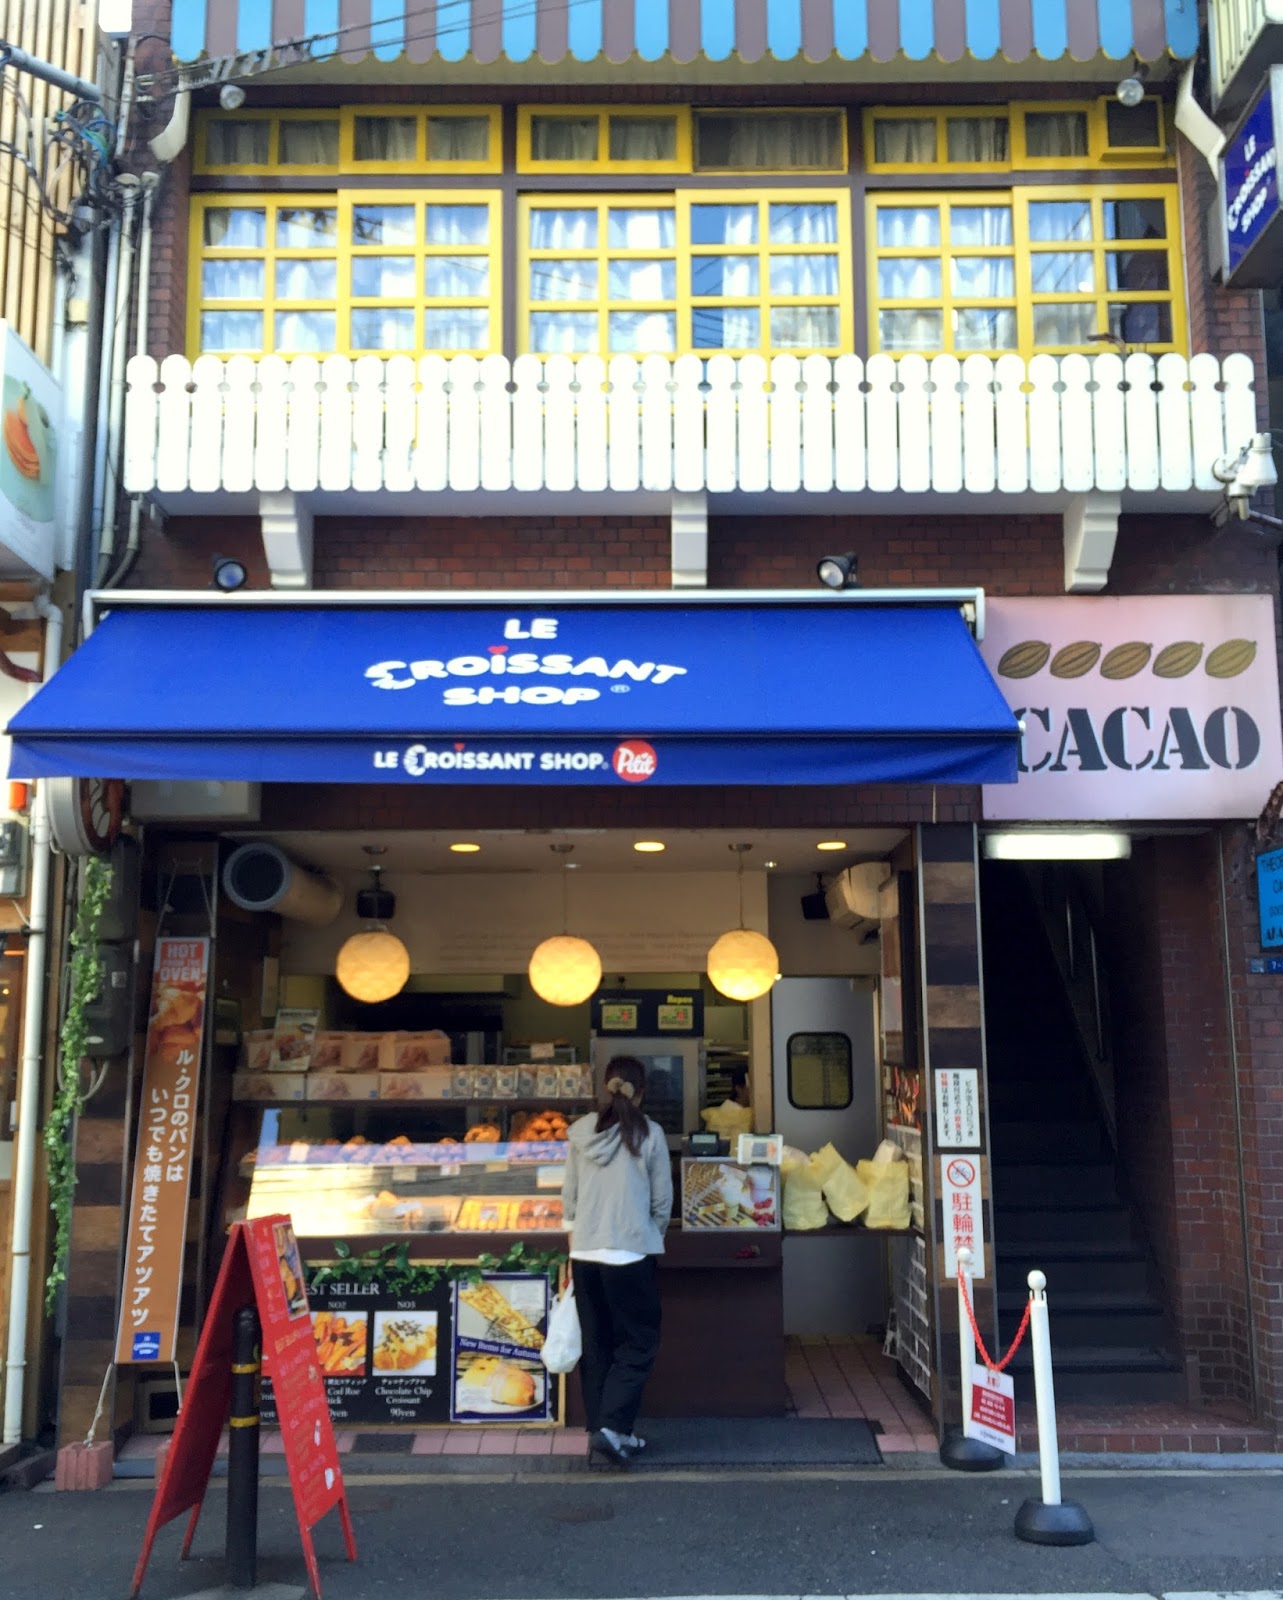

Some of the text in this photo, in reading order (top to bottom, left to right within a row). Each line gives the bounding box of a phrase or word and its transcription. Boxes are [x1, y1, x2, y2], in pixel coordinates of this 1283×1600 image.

[504, 618, 559, 640] LE
[364, 645, 688, 690] CROISSANT
[443, 686, 601, 706] SHOP
[1012, 706, 1260, 773] CACAO
[373, 743, 656, 776] LE CROISSANT SHOP Petit
[167, 943, 199, 958] HOT
[160, 967, 201, 981] OVEN
[166, 1049, 195, 1183] ル・クロのパンは
[131, 1088, 169, 1327] いつでも焼きたてアツアツ
[951, 1192, 976, 1276] 駐輪禁
[329, 1283, 380, 1296] SELLER
[374, 1386, 433, 1399] Chocolate Chip
